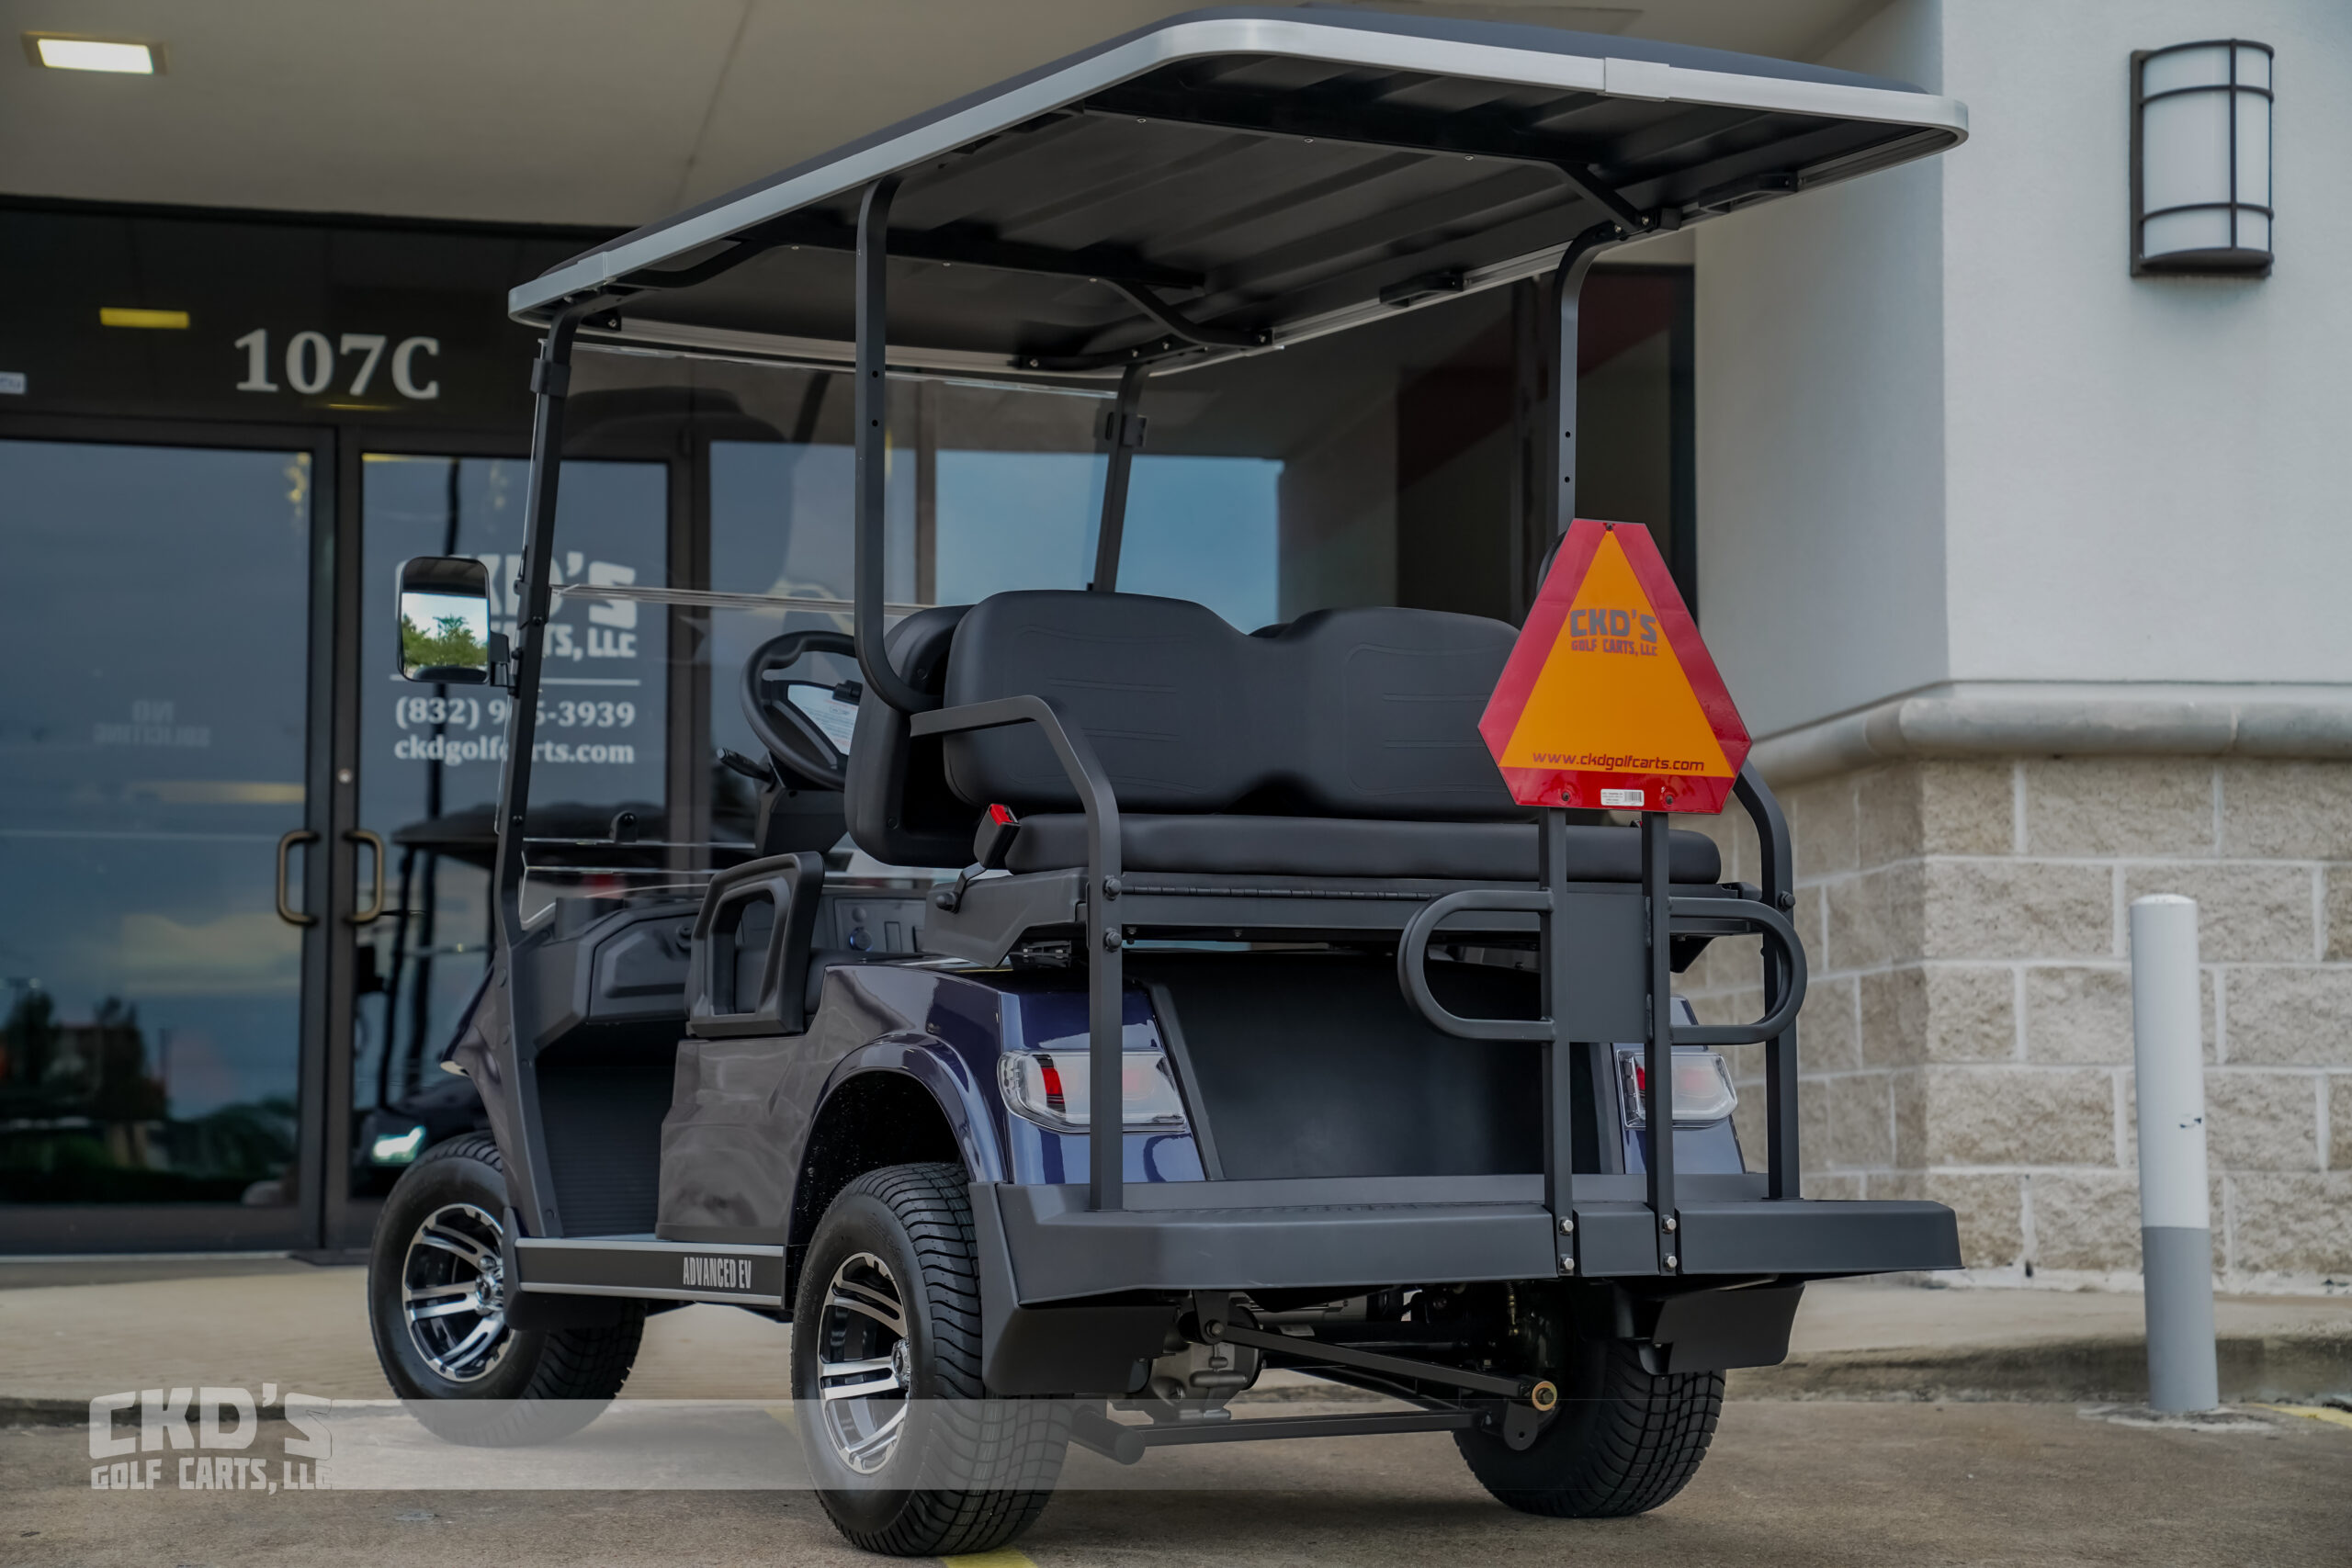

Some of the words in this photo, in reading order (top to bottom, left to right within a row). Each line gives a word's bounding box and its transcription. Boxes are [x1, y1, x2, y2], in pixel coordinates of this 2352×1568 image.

[234, 328, 439, 399] 107C
[1570, 608, 1657, 643] CKD'S
[588, 627, 637, 658] LLC
[1571, 638, 1597, 651] GOLF
[1602, 638, 1638, 657] CARTS,
[1640, 642, 1657, 656] LLC
[395, 696, 480, 729] (832)
[487, 698, 636, 728] 95-3939
[394, 735, 635, 766] ckdgolfcrts.com
[1532, 751, 1704, 771] www.ckdgolfcarts.com
[683, 1257, 737, 1288] ADVANCED
[738, 1259, 752, 1289] EV
